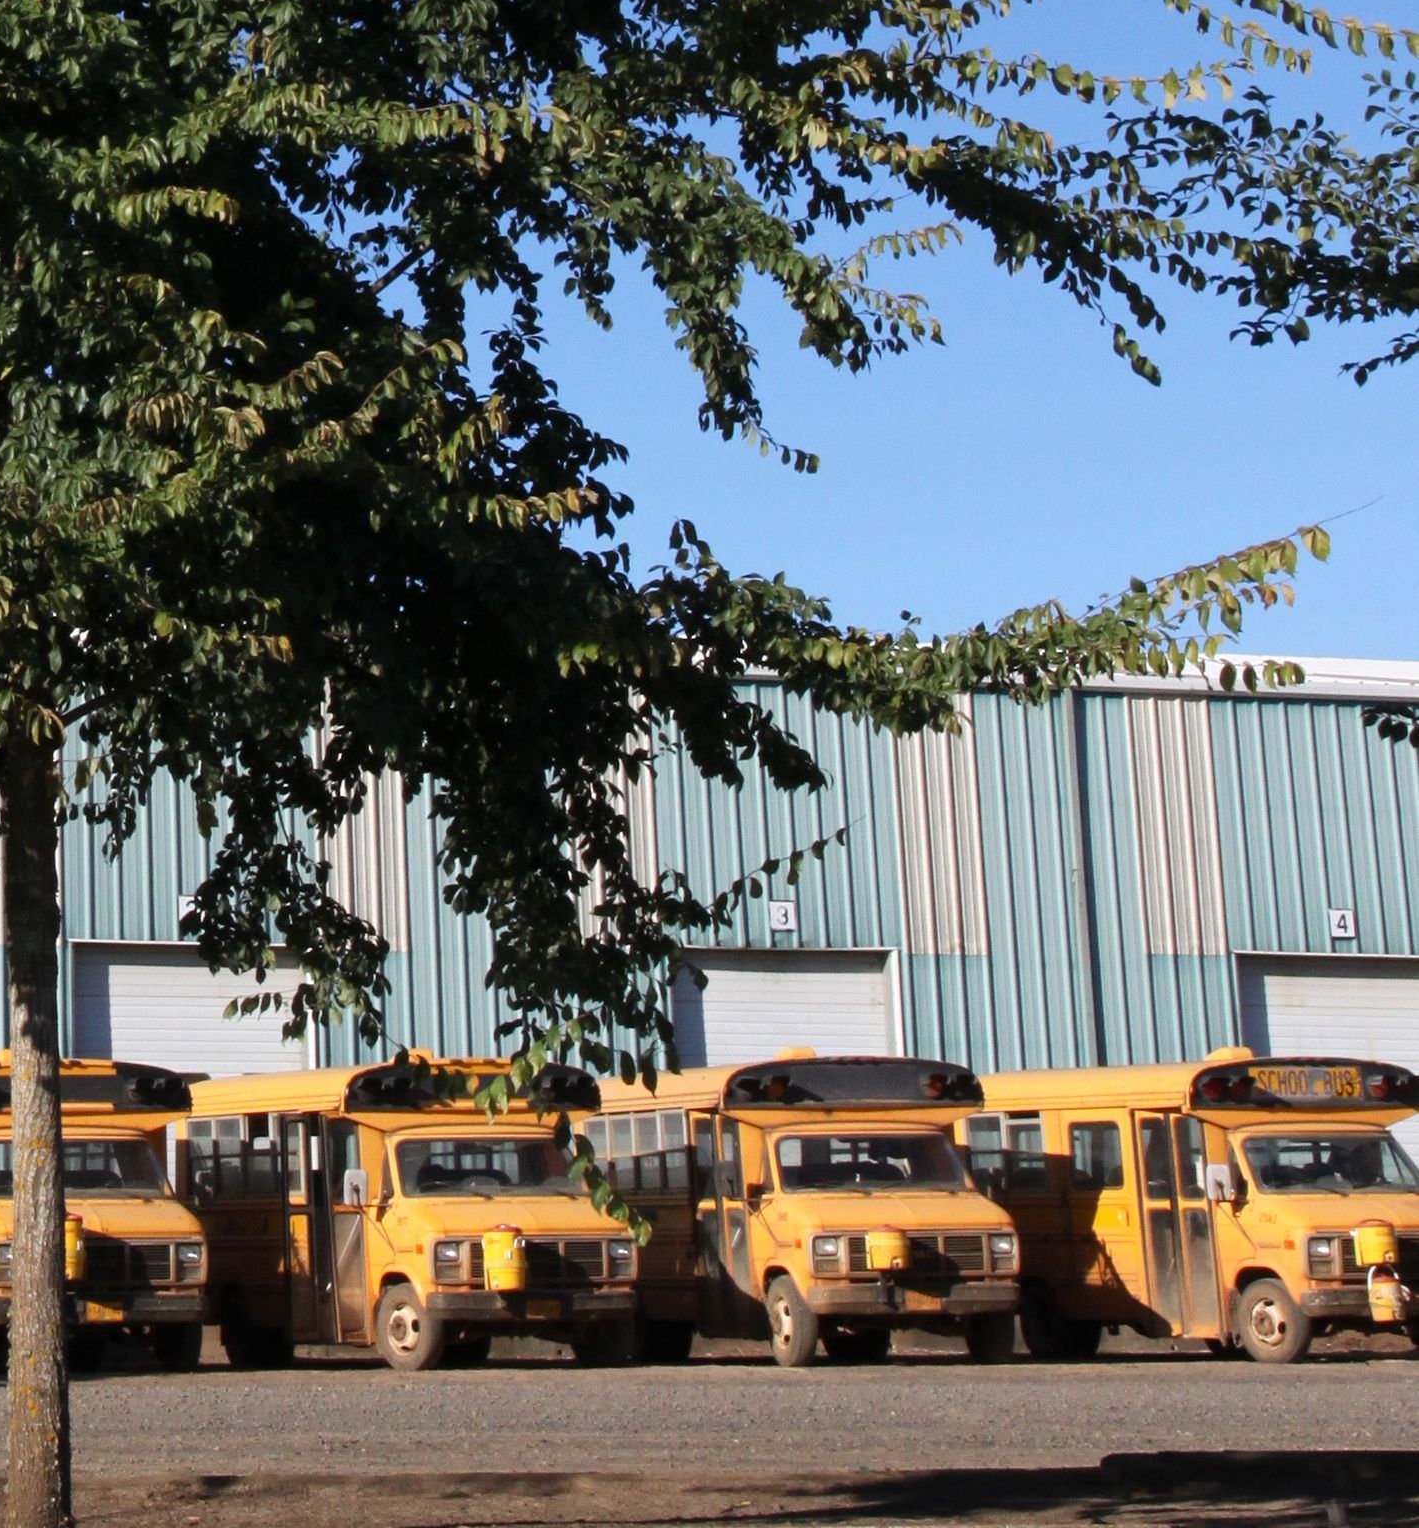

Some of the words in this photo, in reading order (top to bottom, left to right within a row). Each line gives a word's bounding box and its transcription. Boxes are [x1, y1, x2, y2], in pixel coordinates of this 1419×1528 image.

[776, 905, 789, 926] 3
[1337, 913, 1348, 934] 4
[1323, 1071, 1355, 1097] BUS
